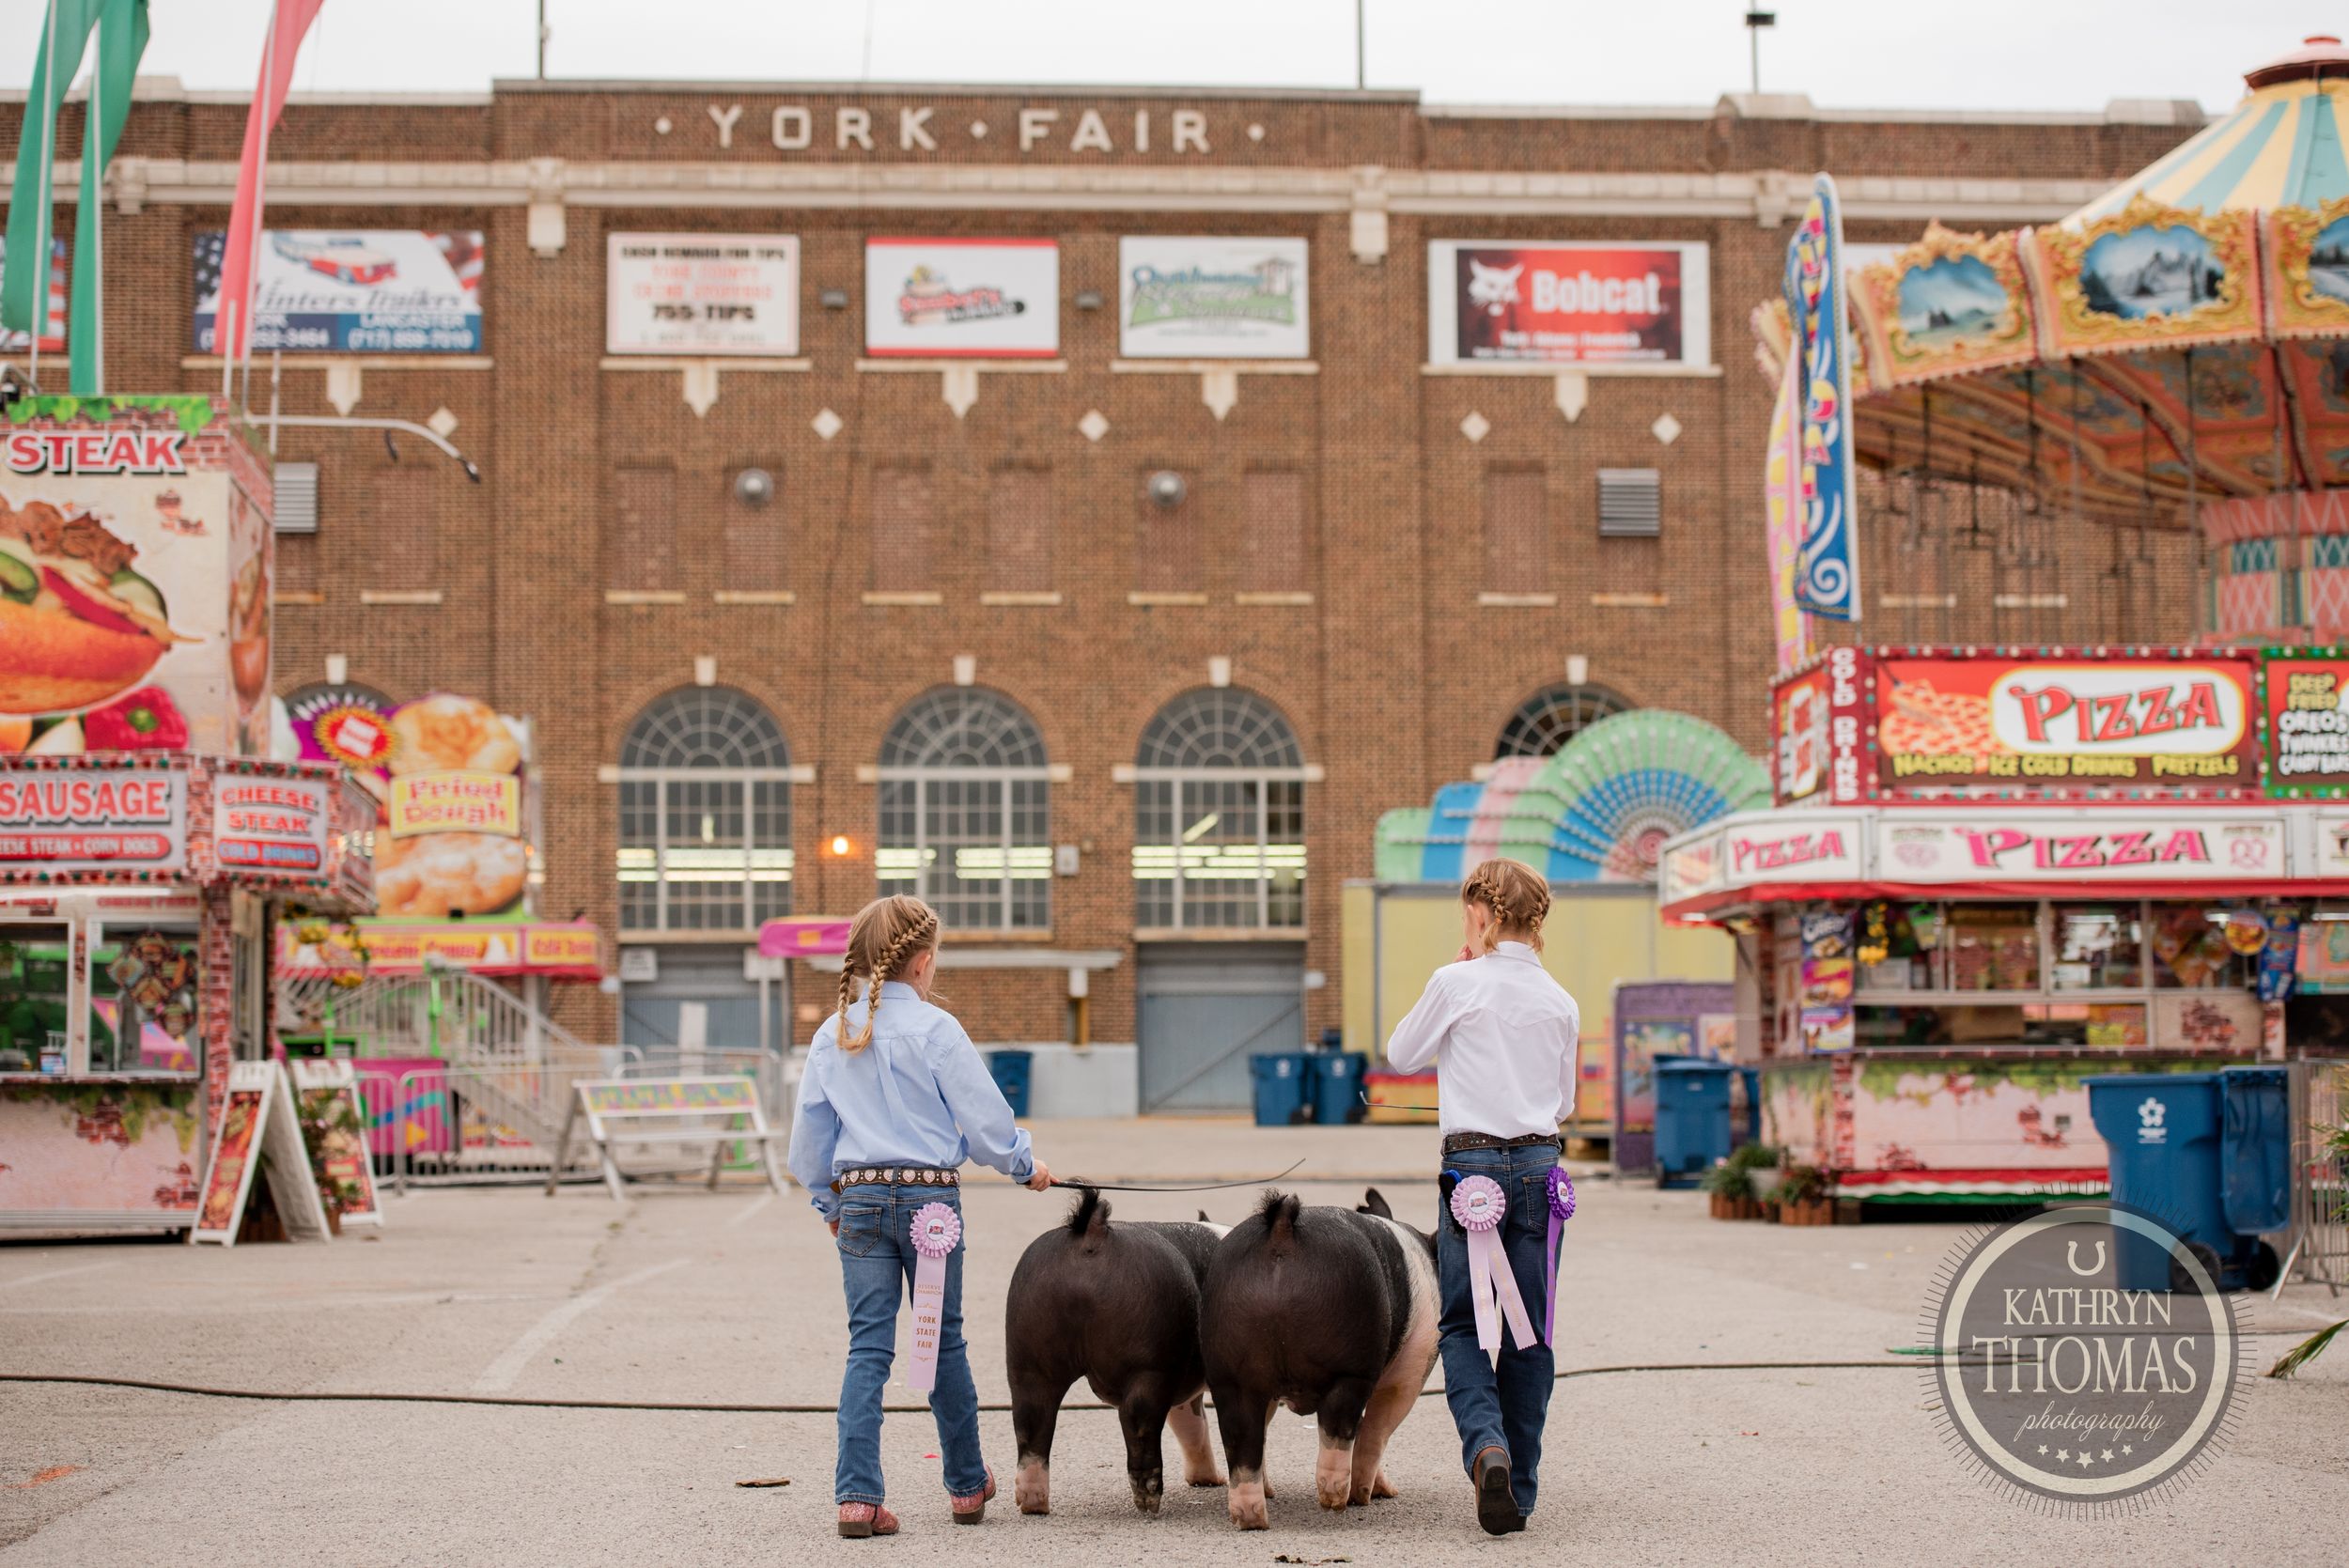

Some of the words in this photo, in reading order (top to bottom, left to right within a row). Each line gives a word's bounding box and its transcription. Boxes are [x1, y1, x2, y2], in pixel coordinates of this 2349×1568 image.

[708, 104, 936, 151] YORK
[1019, 108, 1212, 154] FAIR
[254, 276, 356, 311] inters
[1531, 270, 1662, 315] Bobcat
[7, 429, 188, 475] STEAK
[1831, 646, 1858, 706] COLD
[2290, 674, 2337, 693] DEEP
[2007, 681, 2227, 744] PIZZA
[2287, 692, 2339, 711] FRIED
[2279, 709, 2348, 734] OREOS
[1833, 716, 1859, 801] DRINKS
[1892, 753, 1975, 777] NACHOS
[1988, 753, 2020, 776] ICE
[2021, 753, 2069, 776] COLD
[2070, 753, 2138, 778] DRINKS
[2151, 753, 2241, 777] PRETZELS
[221, 786, 320, 815] CHEESE
[408, 776, 505, 800] Fried
[0, 780, 170, 823] SAUSAGE
[402, 802, 508, 826] Dough
[227, 812, 311, 836] STEAK
[29, 837, 72, 854] STEAK
[83, 837, 119, 855] CORN
[122, 837, 158, 854] DOGS
[217, 840, 259, 859] COLD
[261, 845, 318, 863] DRINKS
[1733, 831, 1847, 872] PIZZA
[1952, 827, 2214, 869] PIZZA
[916, 1327, 937, 1336] STATE
[917, 1315, 937, 1324] YORK
[917, 1340, 933, 1349] FAIR
